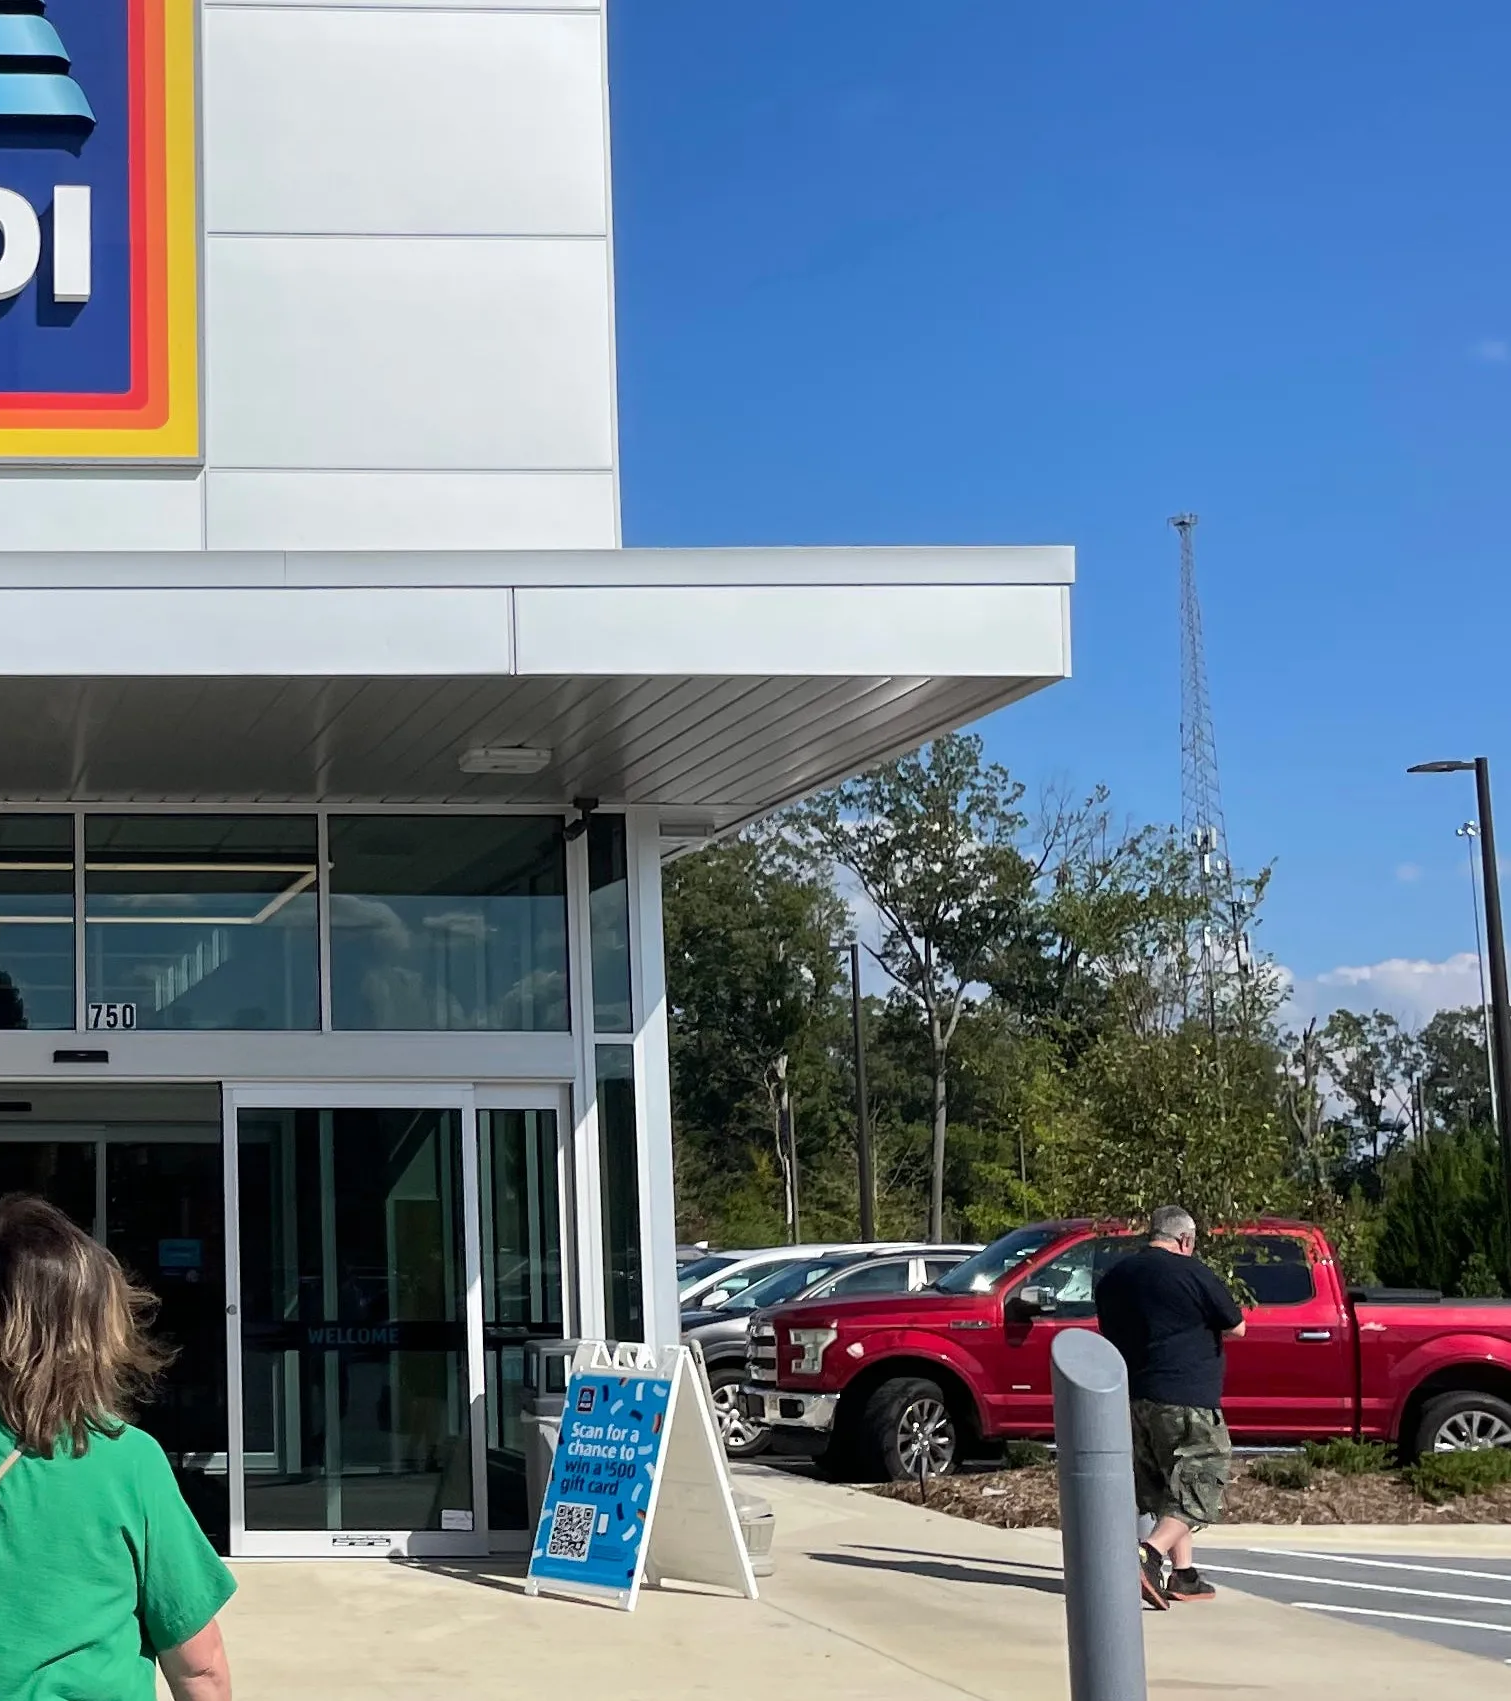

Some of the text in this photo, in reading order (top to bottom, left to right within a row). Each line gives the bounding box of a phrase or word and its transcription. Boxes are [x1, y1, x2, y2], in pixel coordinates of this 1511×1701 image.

[90, 1004, 134, 1029] 750
[308, 1327, 399, 1344] WELCOME
[571, 1421, 640, 1443] Scan for a
[568, 1439, 635, 1460] chance to
[565, 1457, 590, 1474] win
[593, 1462, 602, 1476] a
[560, 1474, 619, 1496] gift card
